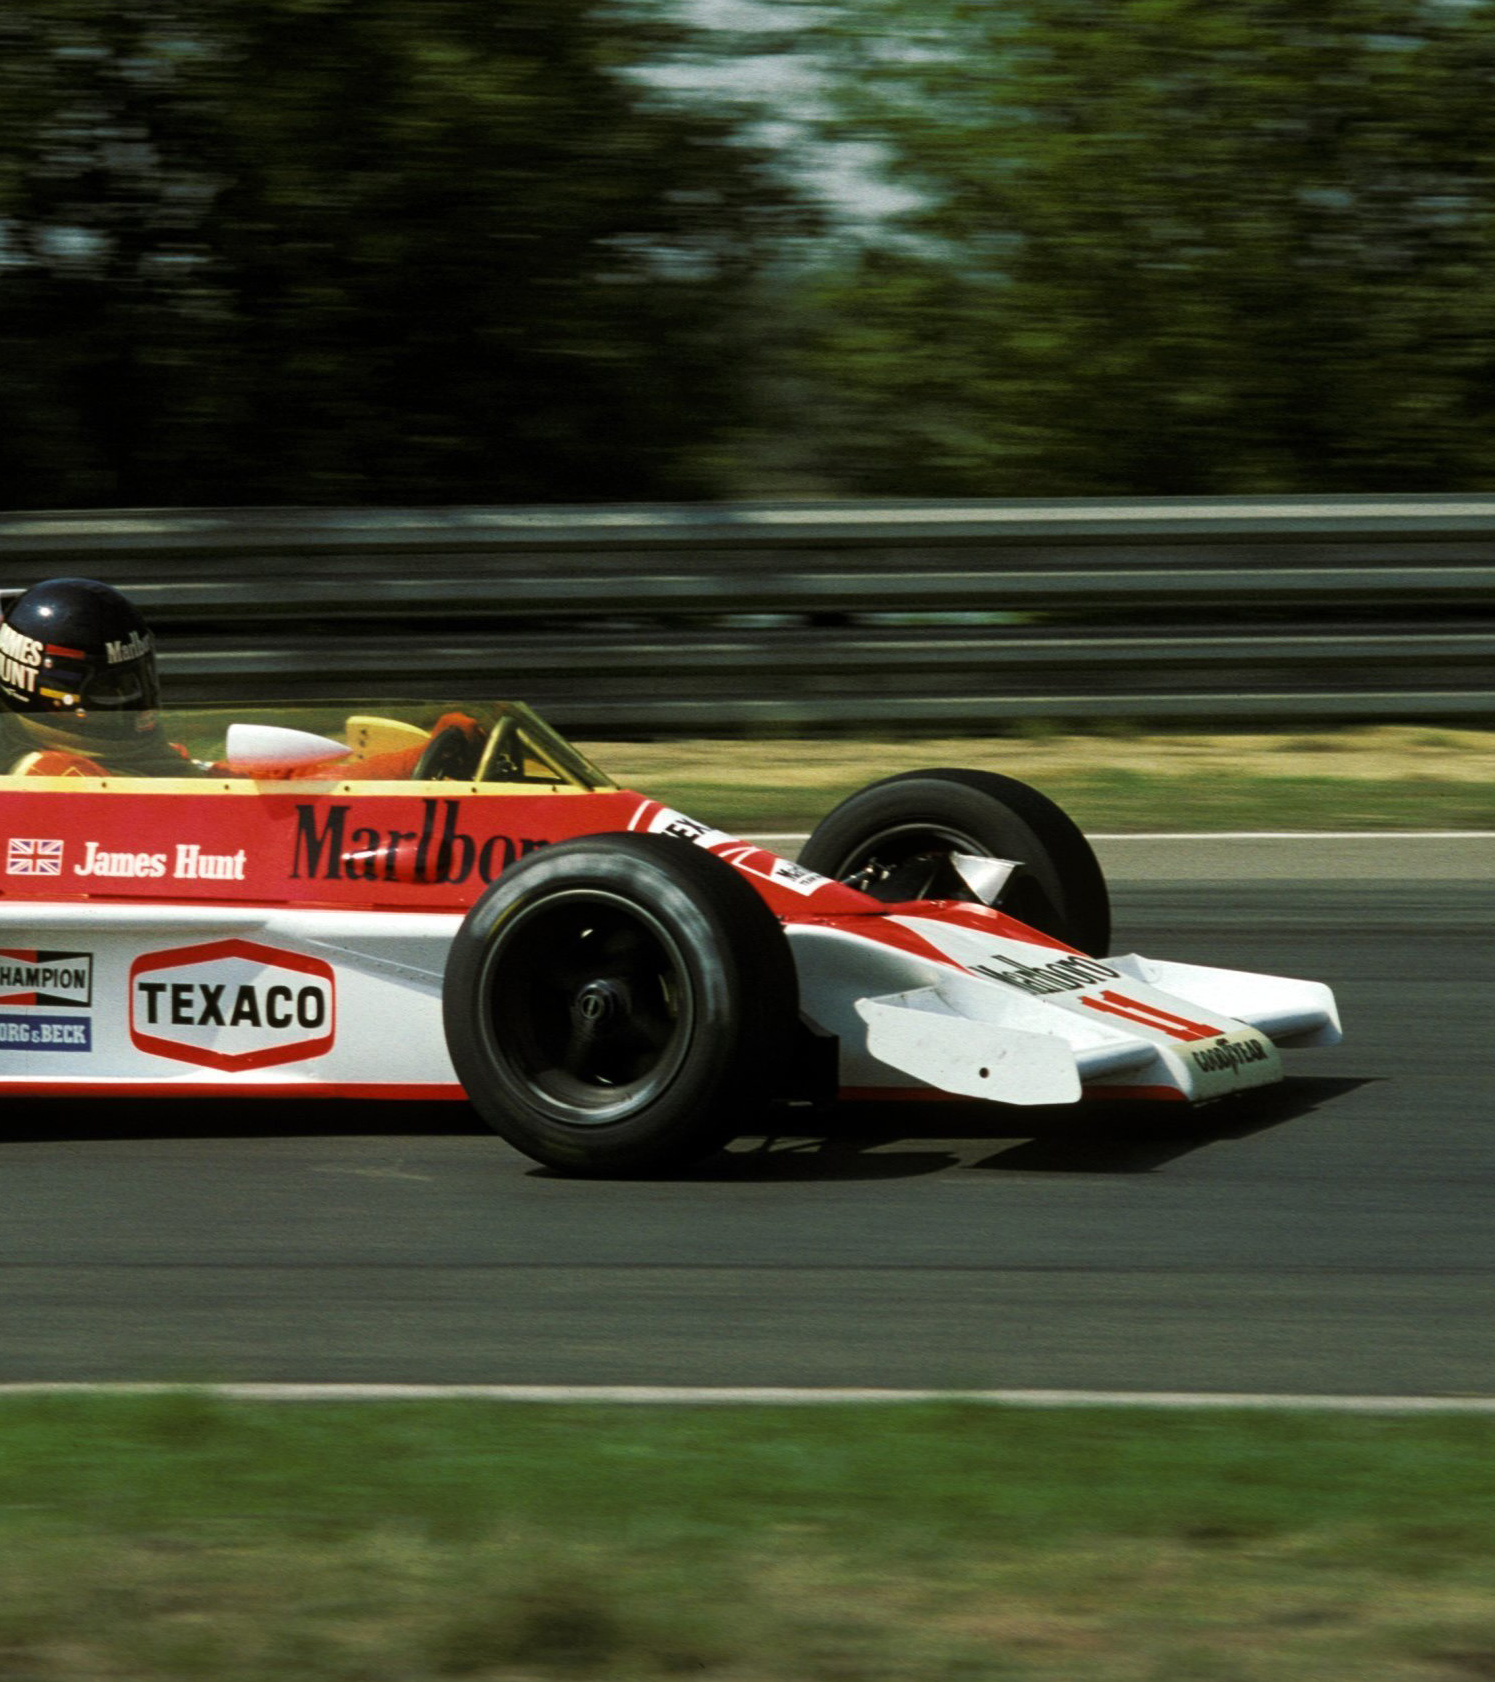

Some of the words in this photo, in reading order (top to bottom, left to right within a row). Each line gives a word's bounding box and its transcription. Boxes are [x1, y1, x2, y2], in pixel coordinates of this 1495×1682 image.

[74, 841, 167, 878] James
[173, 843, 247, 880] Hunt
[289, 798, 551, 885] Marlbo
[968, 954, 1121, 996] Marlboro
[138, 981, 326, 1030] TEXACO
[1076, 990, 1226, 1042] 11
